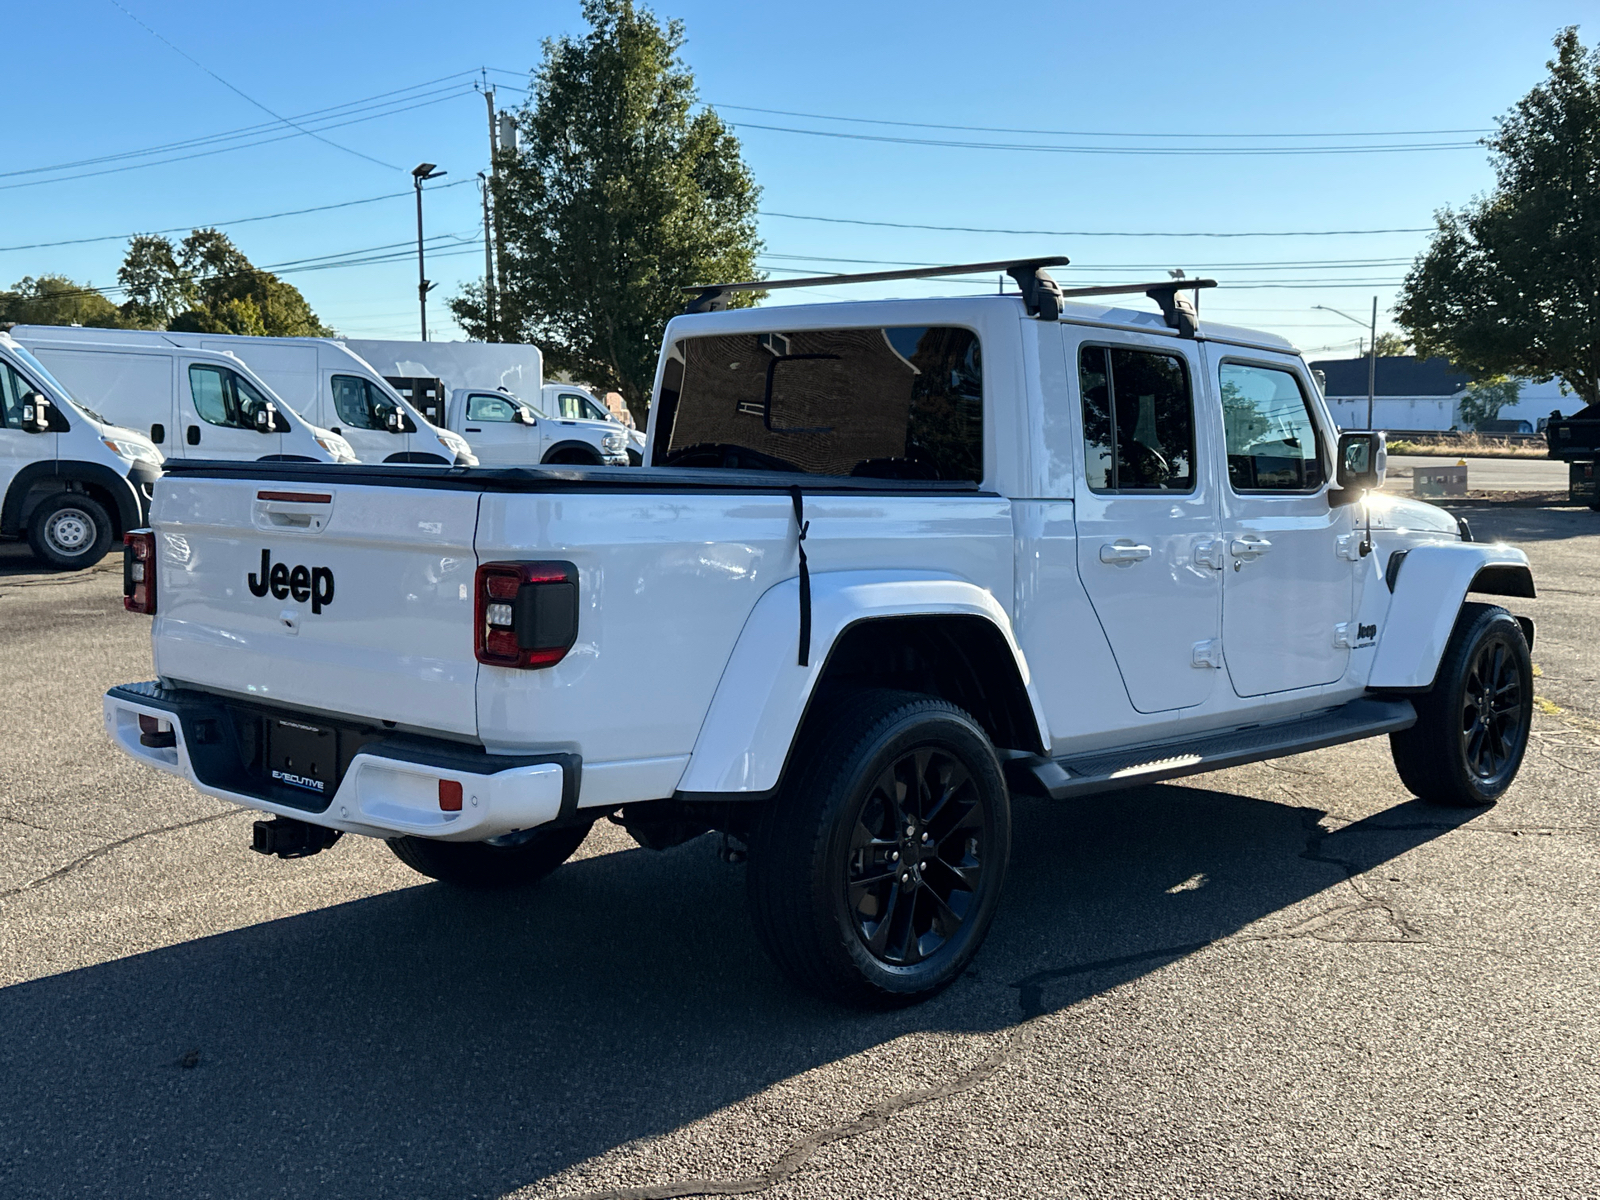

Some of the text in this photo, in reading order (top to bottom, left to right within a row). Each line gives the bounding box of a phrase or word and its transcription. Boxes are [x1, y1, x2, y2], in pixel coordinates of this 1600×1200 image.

[247, 548, 335, 615] Jeep
[1356, 622, 1377, 640] Jeep
[271, 770, 325, 790] EXECUTIVE
